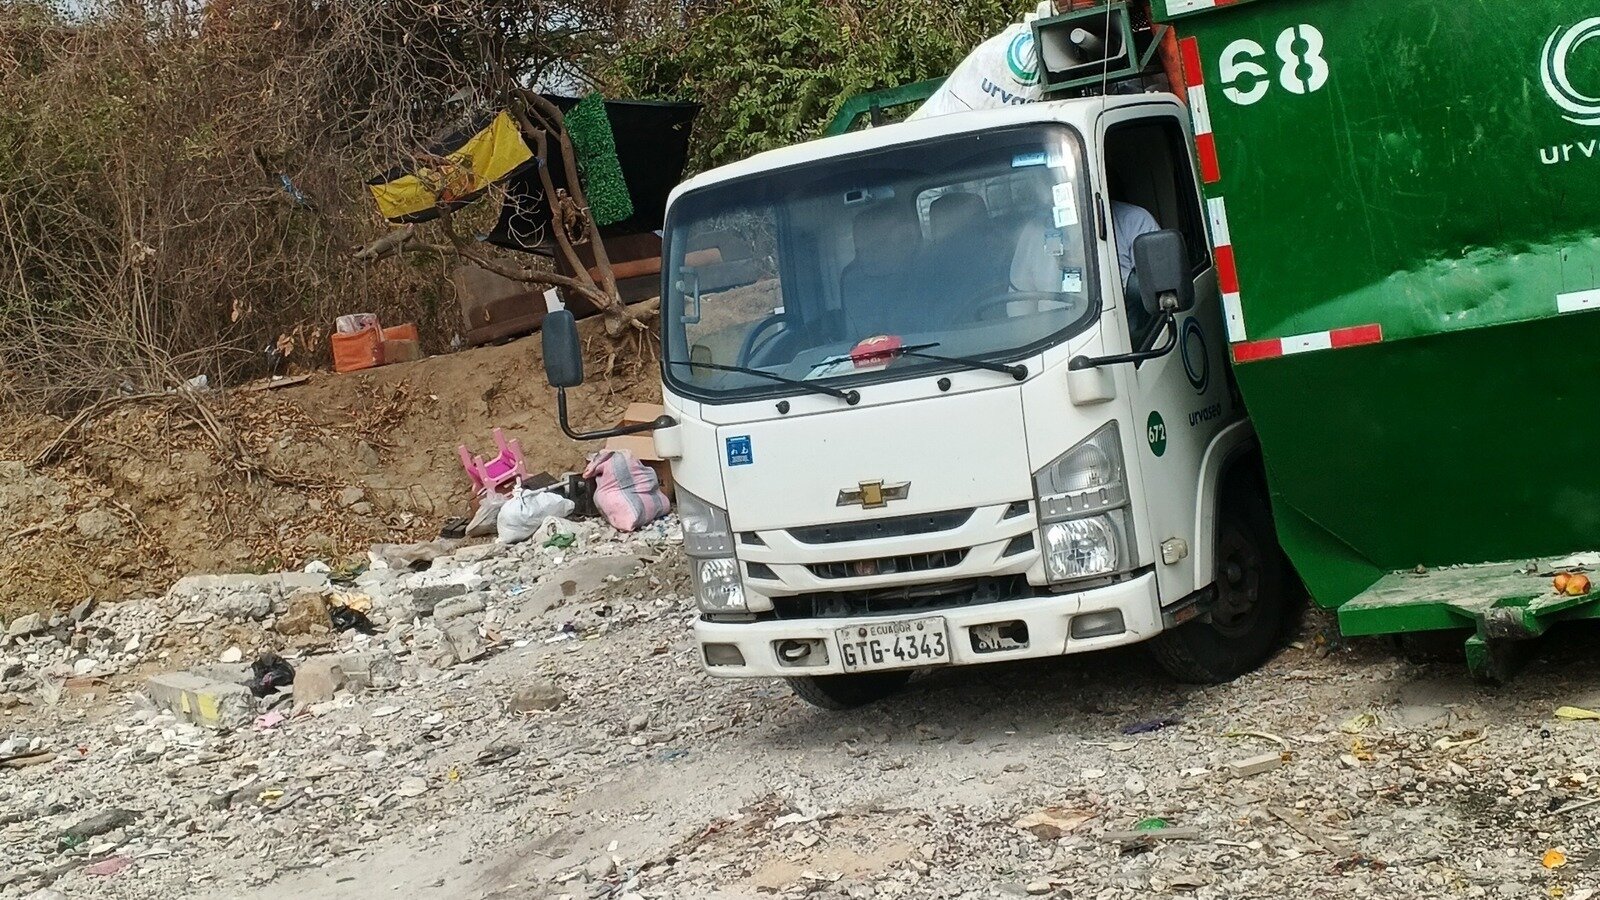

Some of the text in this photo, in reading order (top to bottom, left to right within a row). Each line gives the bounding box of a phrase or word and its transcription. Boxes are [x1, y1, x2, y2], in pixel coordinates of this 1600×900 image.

[1219, 24, 1329, 105] 68
[1540, 139, 1600, 165] urv
[1188, 403, 1222, 427] urvaseo
[1148, 424, 1166, 443] 672
[870, 624, 911, 636] ECUADOR
[842, 632, 945, 666] GTG-4343
